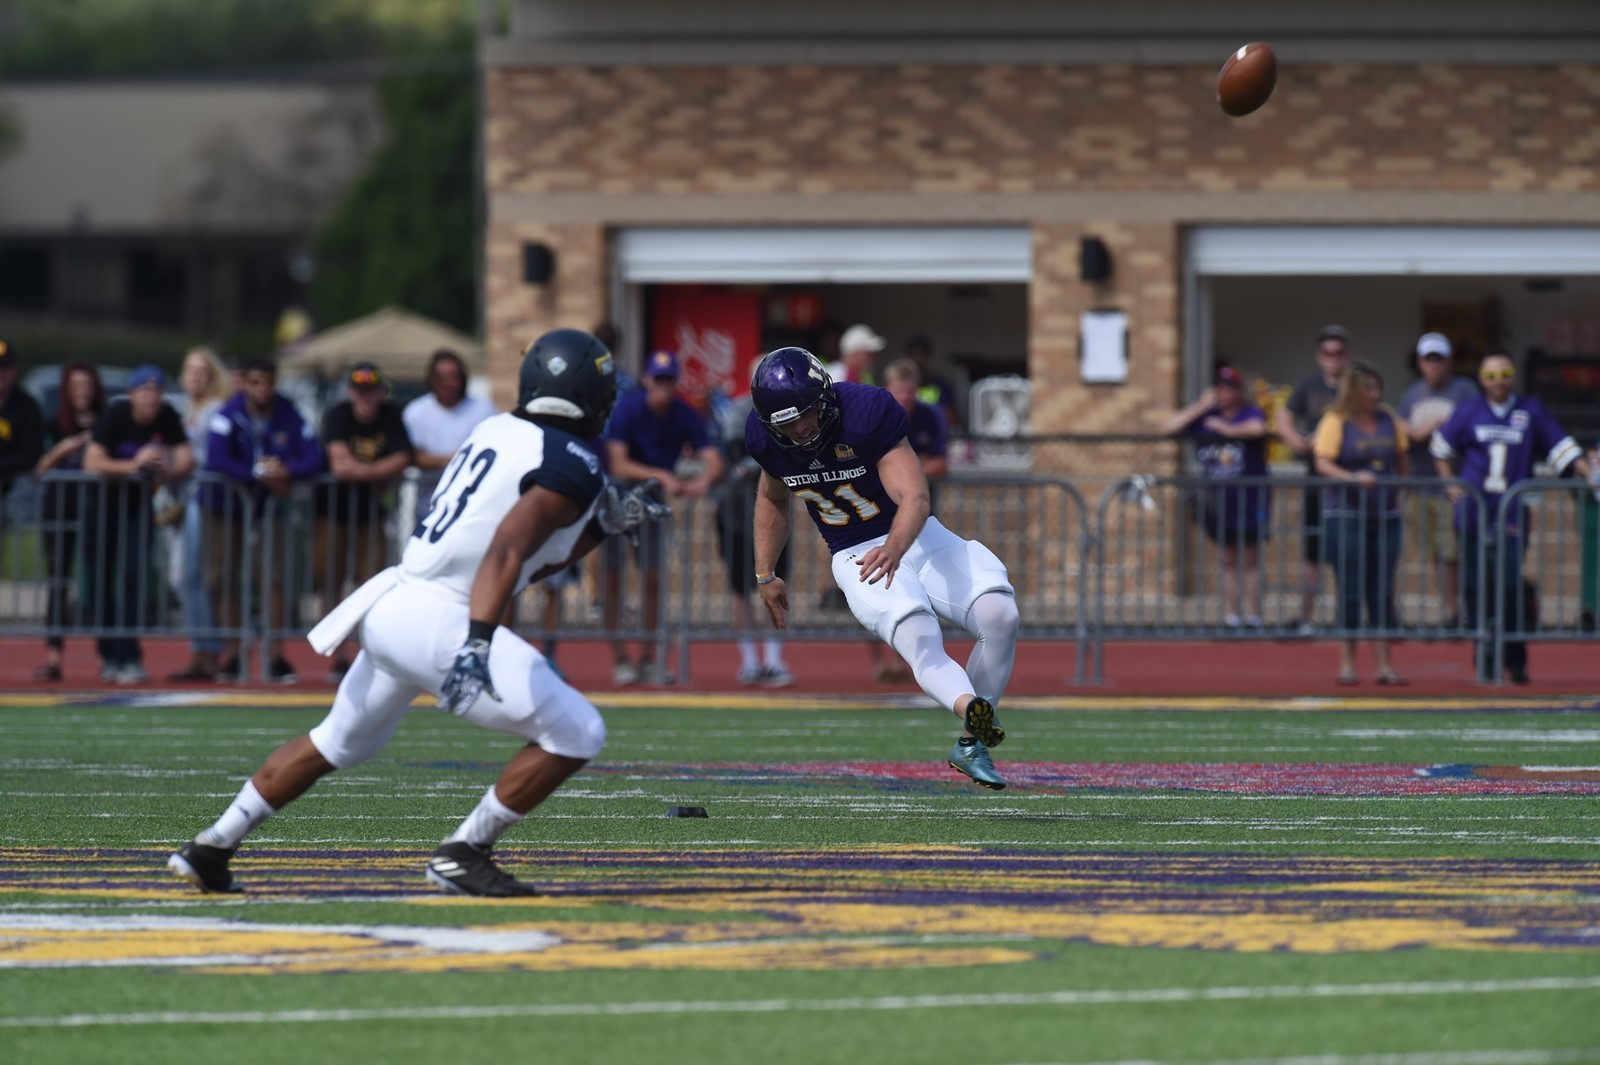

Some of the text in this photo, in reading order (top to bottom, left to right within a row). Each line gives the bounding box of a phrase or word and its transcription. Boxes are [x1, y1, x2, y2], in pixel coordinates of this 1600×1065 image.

[822, 465, 867, 482] ILLINOIS
[1484, 442, 1508, 493] 1
[412, 443, 497, 544] 23
